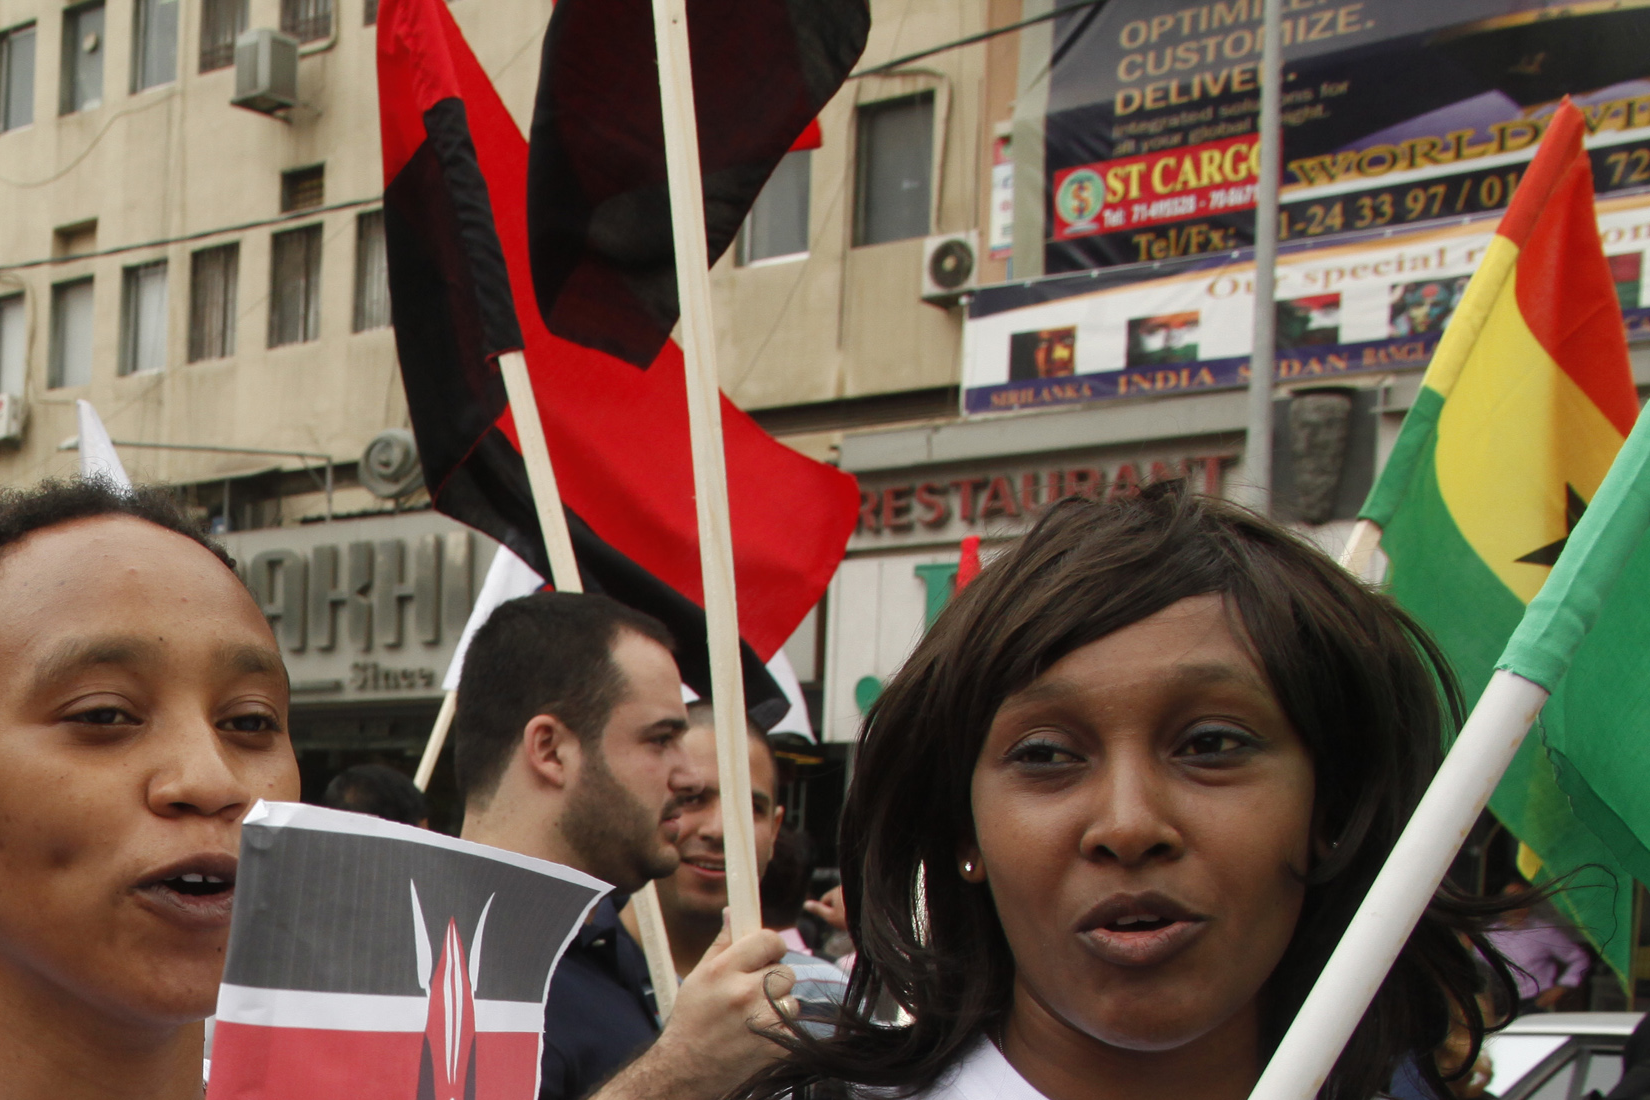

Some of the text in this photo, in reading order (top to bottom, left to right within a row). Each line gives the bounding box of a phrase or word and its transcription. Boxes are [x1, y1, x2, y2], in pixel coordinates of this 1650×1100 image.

[1105, 162, 1147, 204] ST
[1132, 223, 1238, 261] Tel/Fx:
[1354, 193, 1395, 230] 33
[1405, 184, 1449, 220] 97
[1303, 246, 1449, 291] special
[1117, 366, 1216, 396] INDIA
[1238, 353, 1348, 383] SDAN
[351, 662, 437, 691] Since
